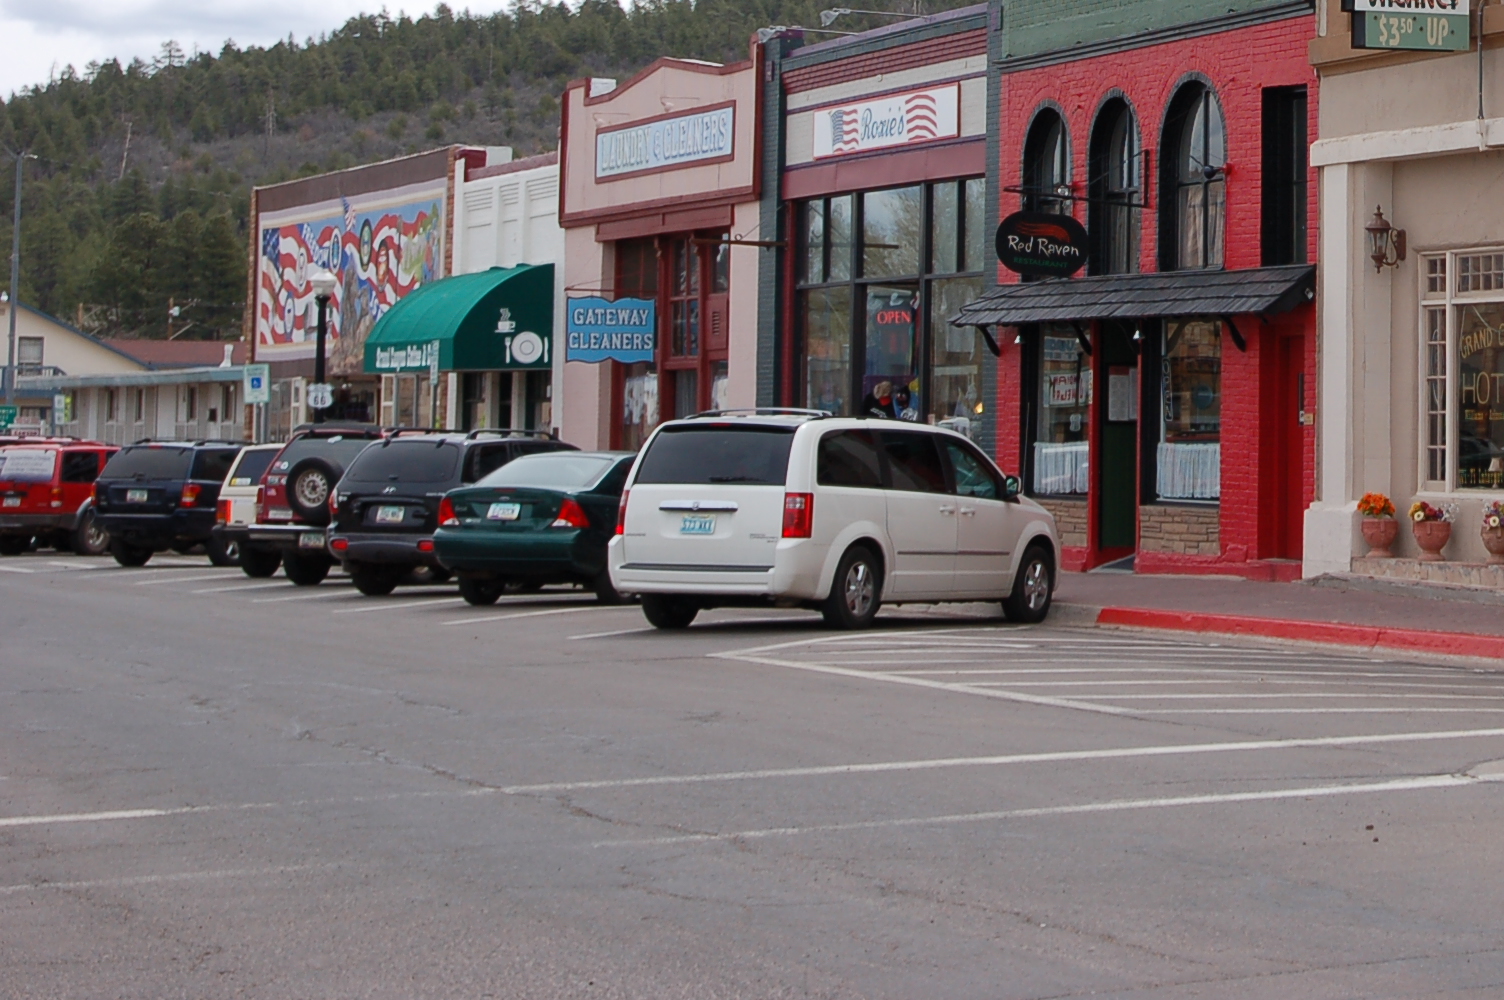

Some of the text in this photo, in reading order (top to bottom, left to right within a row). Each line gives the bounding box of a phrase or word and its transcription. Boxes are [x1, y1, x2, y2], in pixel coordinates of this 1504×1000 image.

[1426, 16, 1449, 46] UP
[861, 106, 905, 141] Roxie's
[601, 126, 651, 172] LAUNDRY
[662, 112, 727, 160] CLEANERS
[1007, 234, 1080, 258] Red Raven
[1013, 257, 1069, 268] RESTAURANT
[573, 308, 649, 326] GATEWAY
[876, 310, 912, 324] OPEN
[569, 332, 653, 350] CLEANERS
[1460, 327, 1493, 359] GRAND
[313, 395, 326, 406] 66
